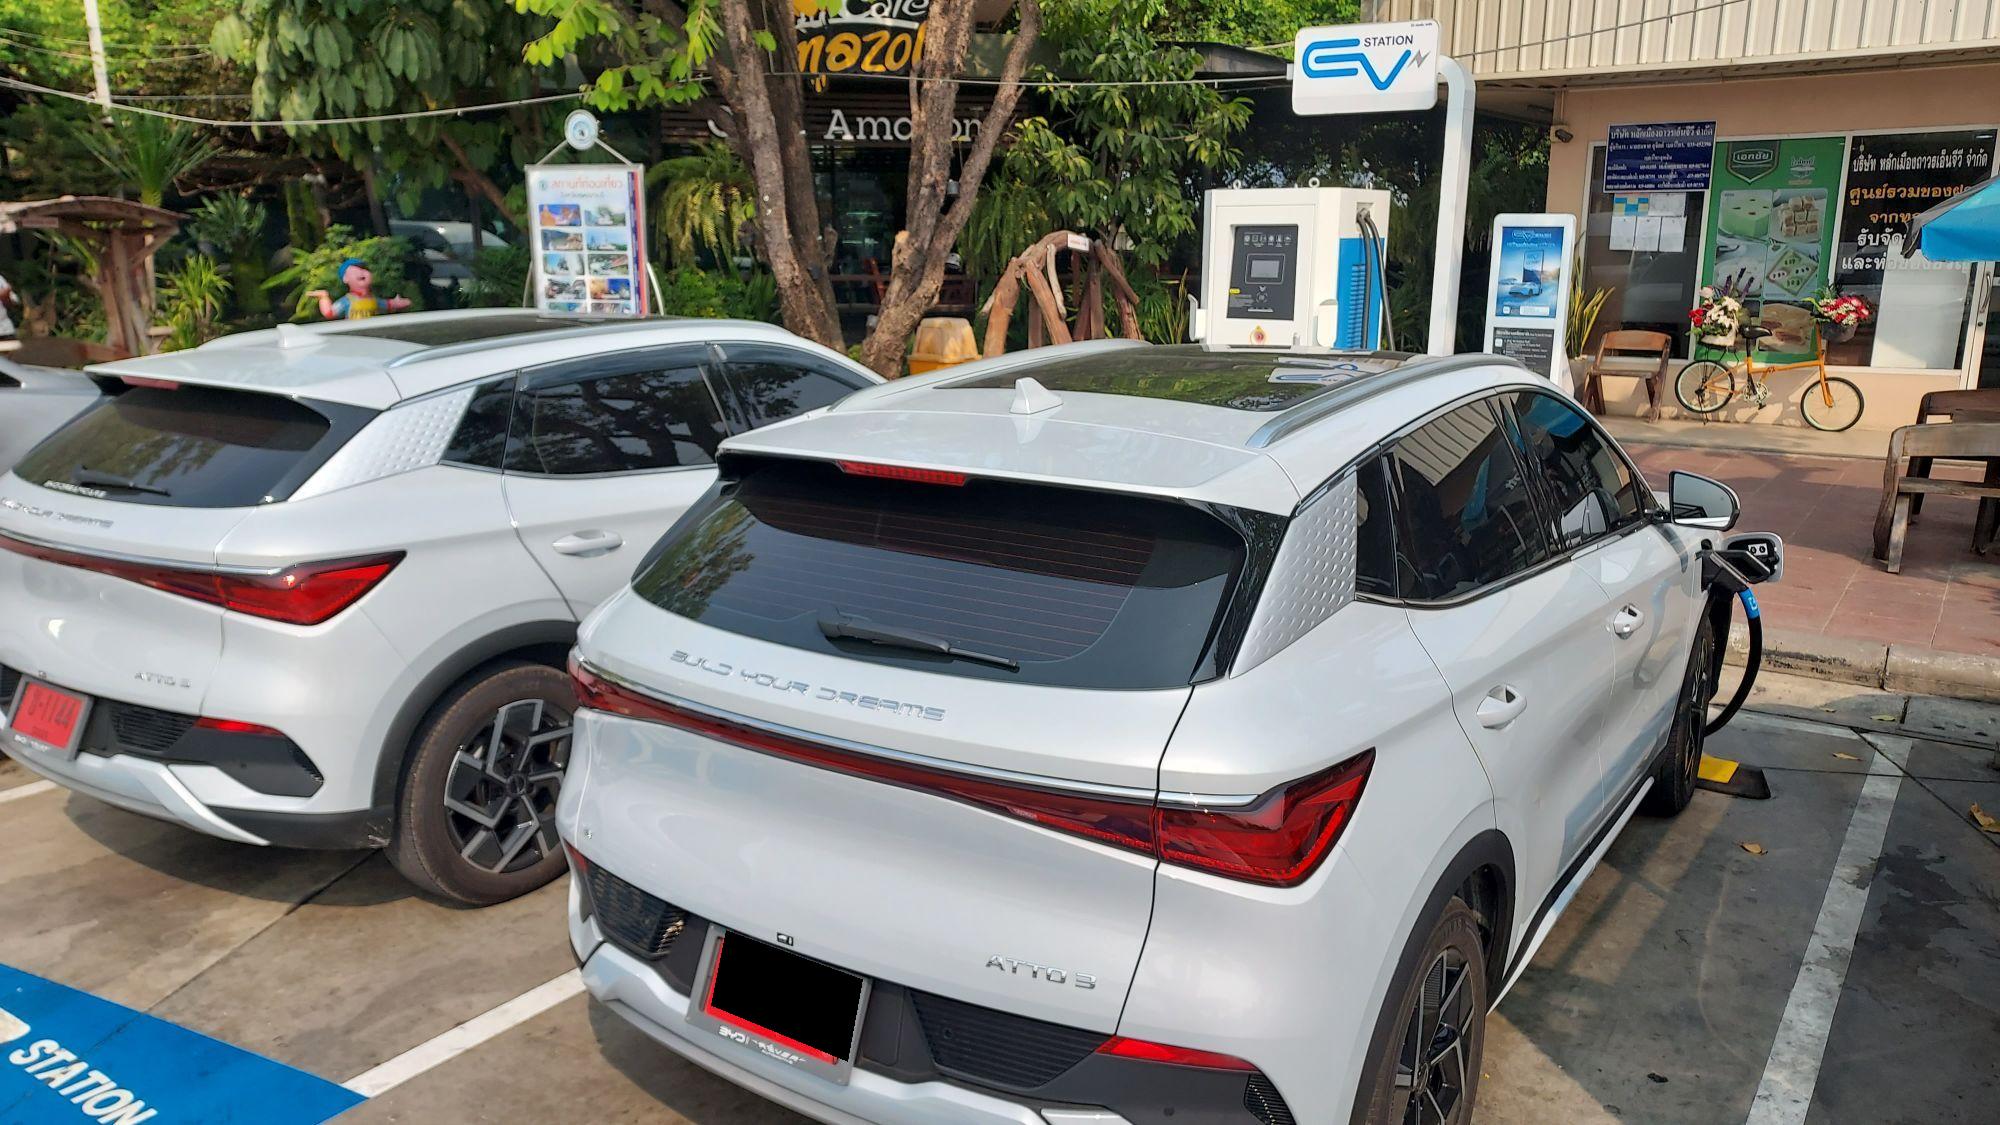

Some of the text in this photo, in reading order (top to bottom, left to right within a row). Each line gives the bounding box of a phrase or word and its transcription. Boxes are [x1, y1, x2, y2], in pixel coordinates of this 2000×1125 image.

[1364, 35, 1414, 48] STATION
[1302, 38, 1412, 91] EV
[1853, 154, 1877, 172] บริษัท
[1966, 148, 1988, 167] จำกัด
[670, 650, 946, 722] BUILD YOUR DREAMS
[986, 953, 1097, 989] ATTO 3
[8, 1039, 158, 1125] STATION
